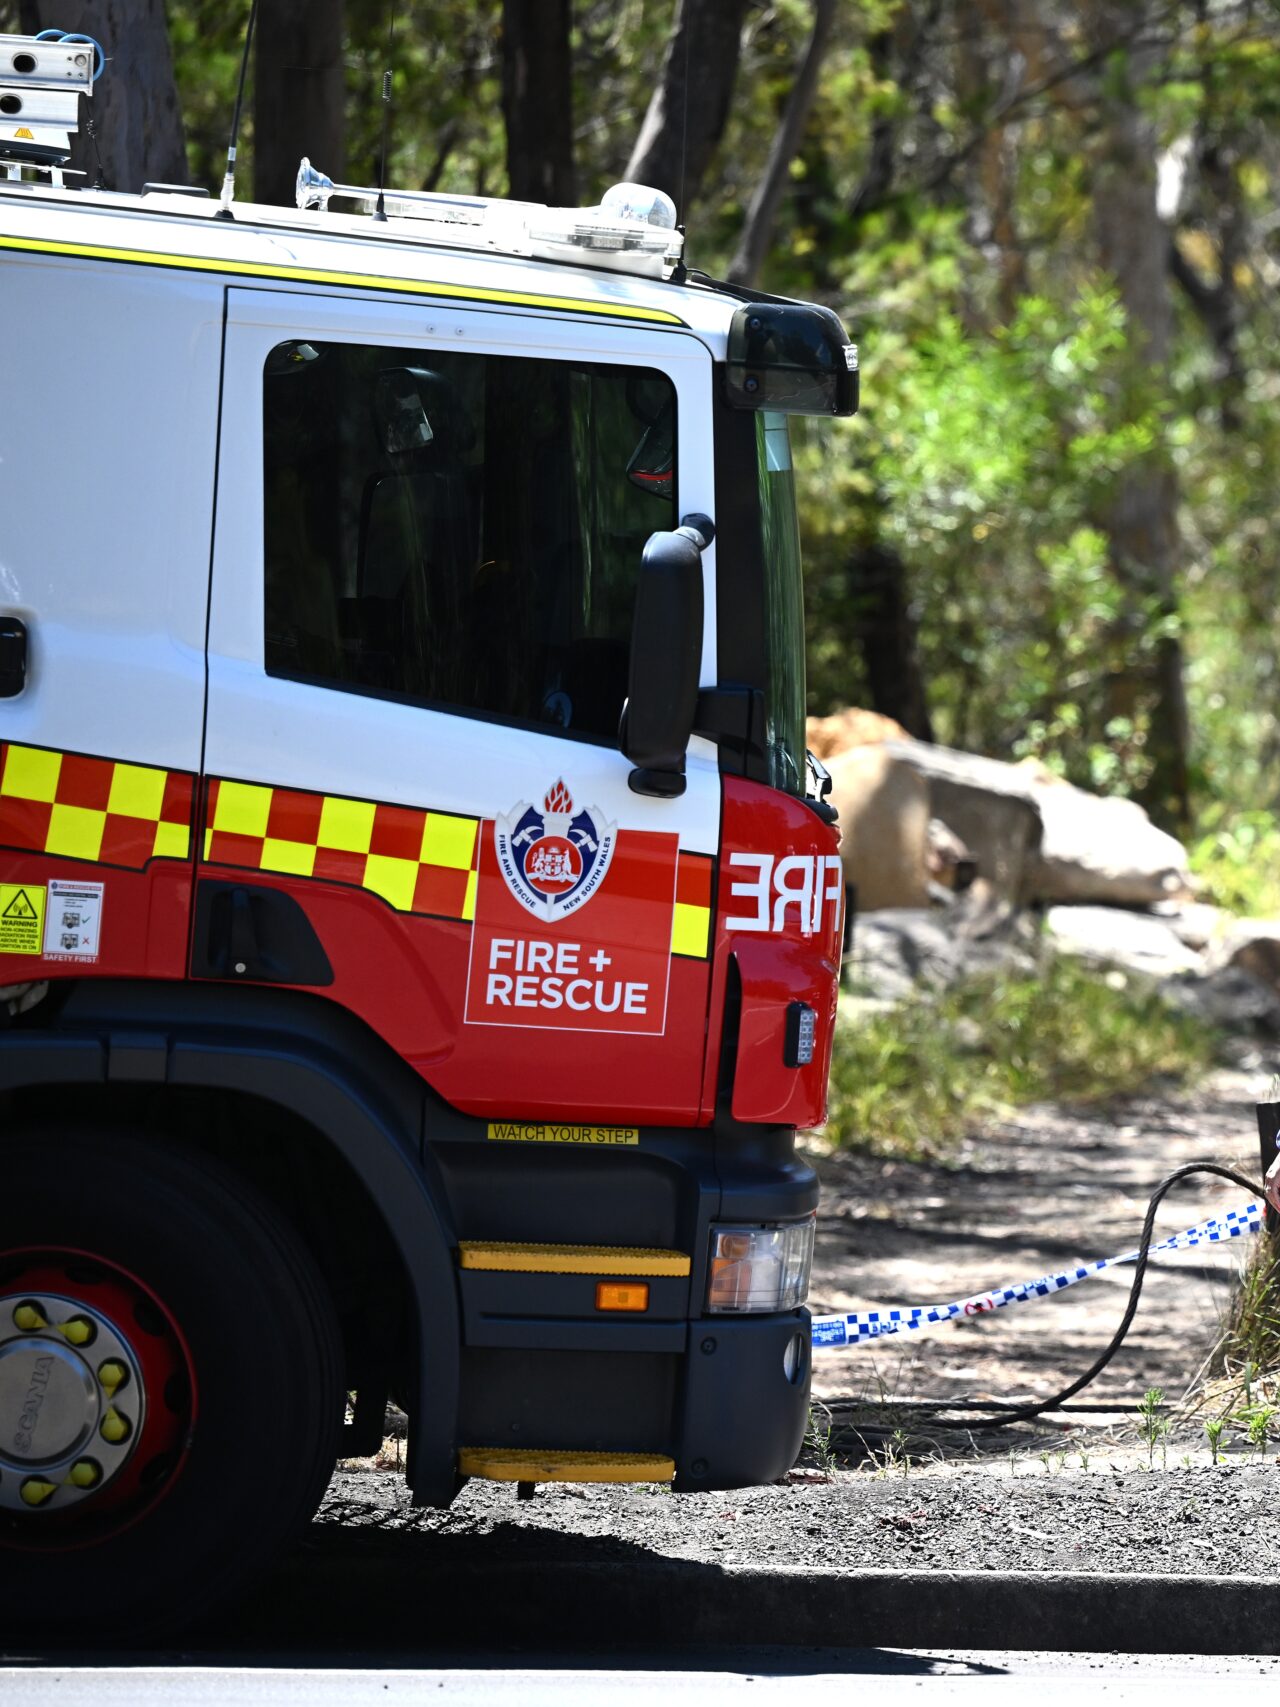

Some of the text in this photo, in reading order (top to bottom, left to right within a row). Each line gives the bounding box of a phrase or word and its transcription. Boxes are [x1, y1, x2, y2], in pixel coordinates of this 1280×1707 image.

[499, 834, 537, 909] FIRE AND RESCUE
[563, 836, 611, 911] NEW SOUTH WALES
[2, 920, 38, 928] WARNING
[44, 954, 73, 962] SAFETY
[489, 938, 581, 974] FIRE
[486, 975, 649, 1015] RESCUE
[494, 1124, 634, 1144] WATCH YOUR STEP
[14, 1356, 55, 1454] SCANIA
